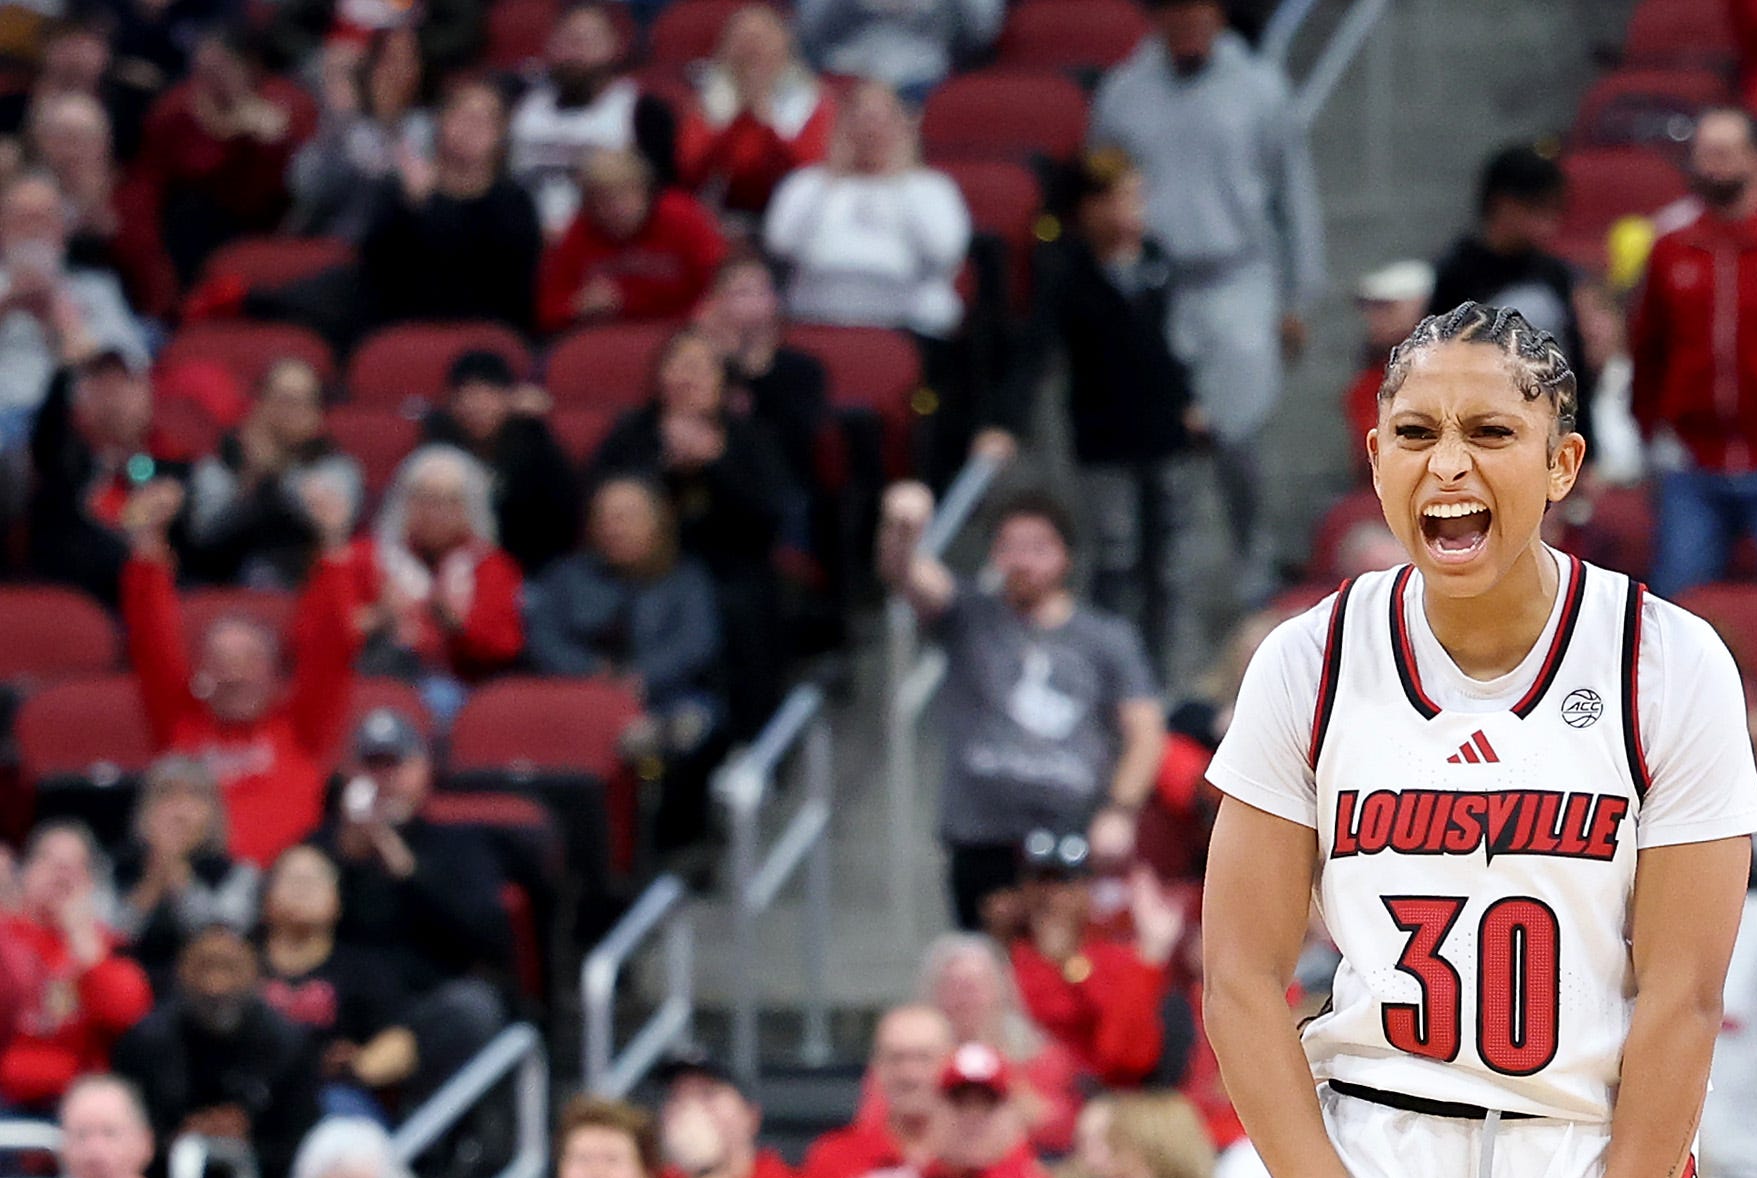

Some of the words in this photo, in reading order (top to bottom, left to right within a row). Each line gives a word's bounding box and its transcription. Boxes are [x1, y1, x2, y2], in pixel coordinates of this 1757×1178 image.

[1566, 701, 1601, 711] ACC
[1330, 789, 1630, 867] LOUISVILLE
[1379, 895, 1561, 1078] 30
